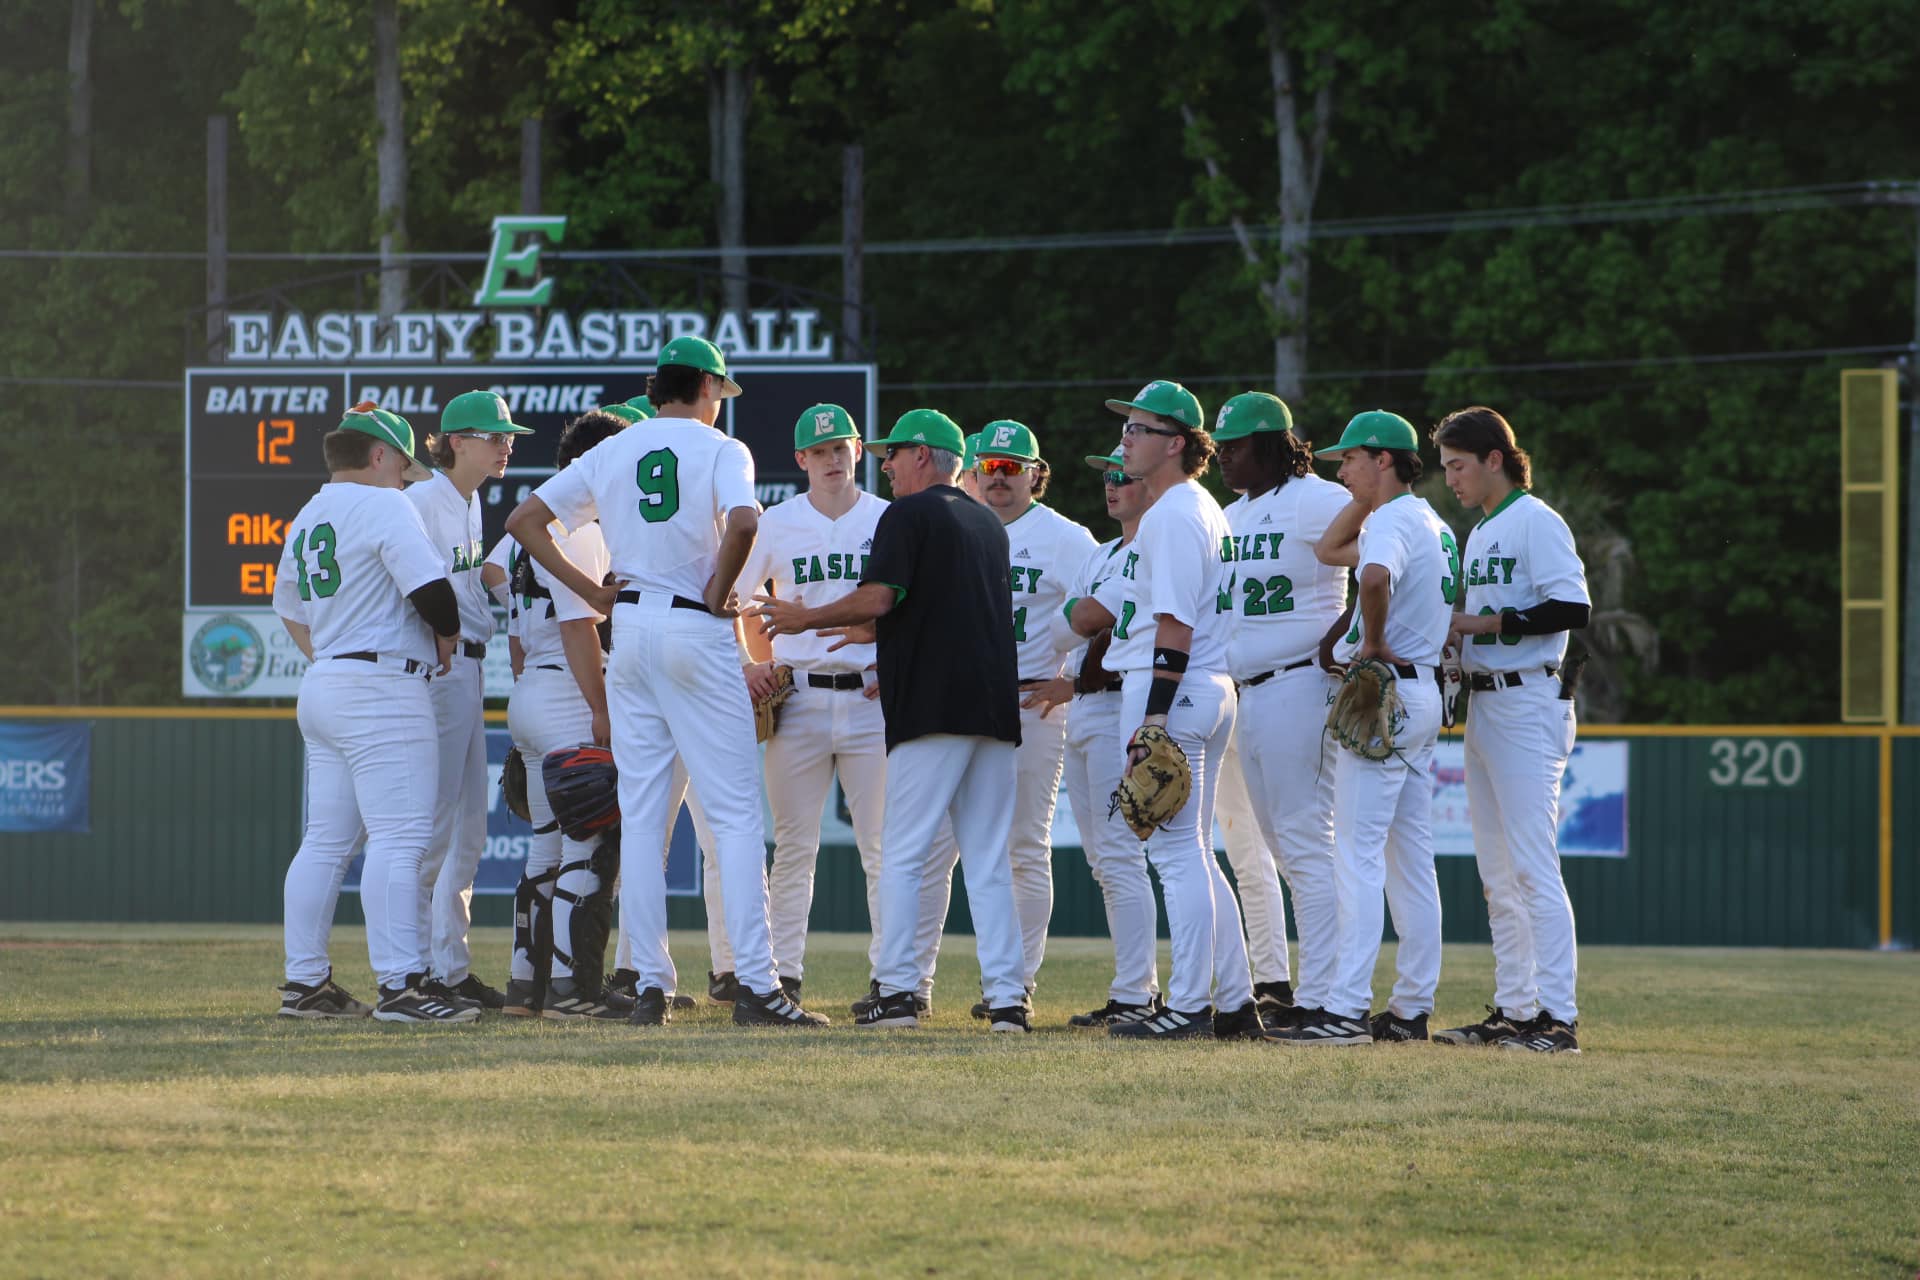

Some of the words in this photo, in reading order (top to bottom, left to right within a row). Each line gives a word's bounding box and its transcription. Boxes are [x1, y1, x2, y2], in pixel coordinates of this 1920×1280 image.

[474, 216, 567, 306] E
[227, 312, 482, 361] EASLEY
[492, 308, 834, 361] BASEBALL
[206, 387, 329, 413] BATTER
[360, 386, 439, 413] BALL
[257, 419, 295, 464] 12
[636, 446, 680, 523] 9
[293, 521, 342, 601] 13
[1440, 531, 1460, 605] 3
[1463, 556, 1517, 593] SLEY
[1243, 574, 1295, 617] 22
[1709, 739, 1803, 786] 320
